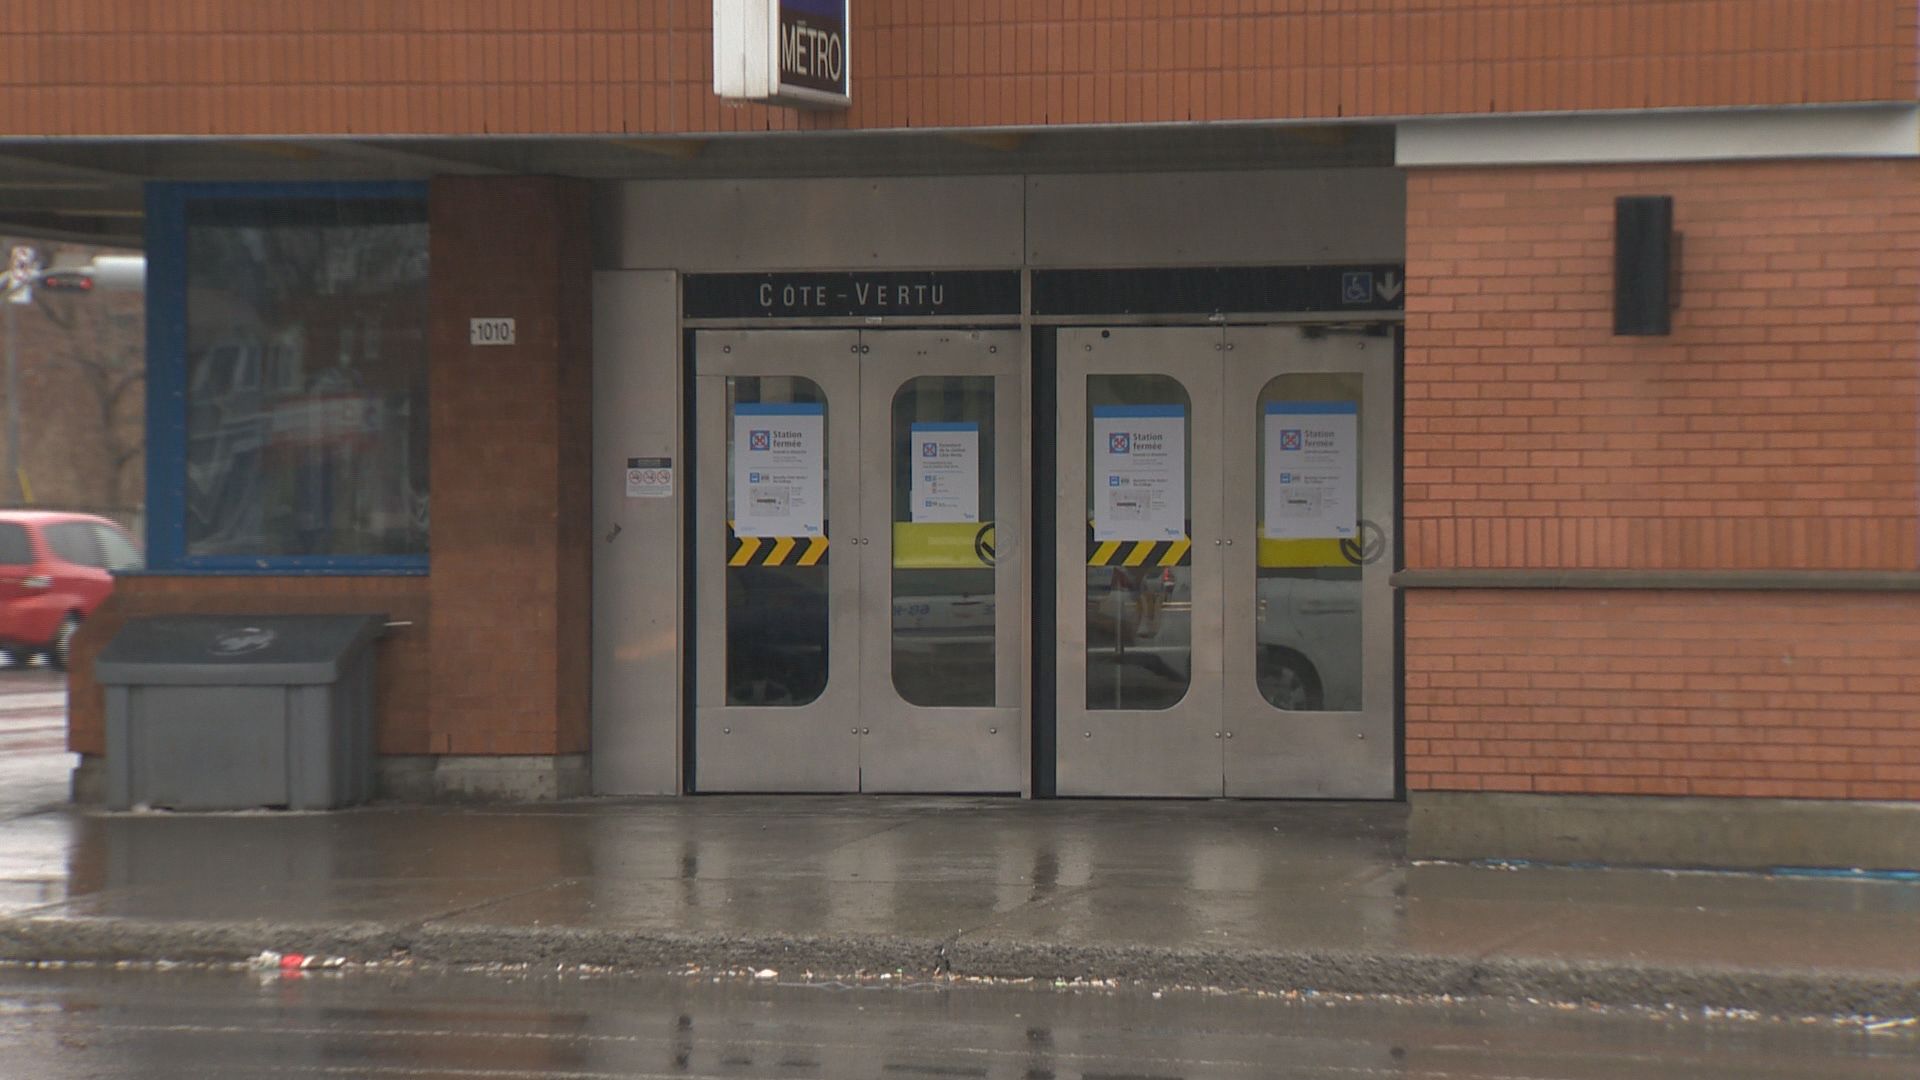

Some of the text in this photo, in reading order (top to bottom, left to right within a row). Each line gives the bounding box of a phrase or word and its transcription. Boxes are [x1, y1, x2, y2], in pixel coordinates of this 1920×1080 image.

[478, 322, 510, 340] 1010
[773, 430, 802, 439] Station
[1132, 432, 1163, 441] Station
[773, 439, 802, 448] fermée
[1132, 442, 1162, 450] fermée
